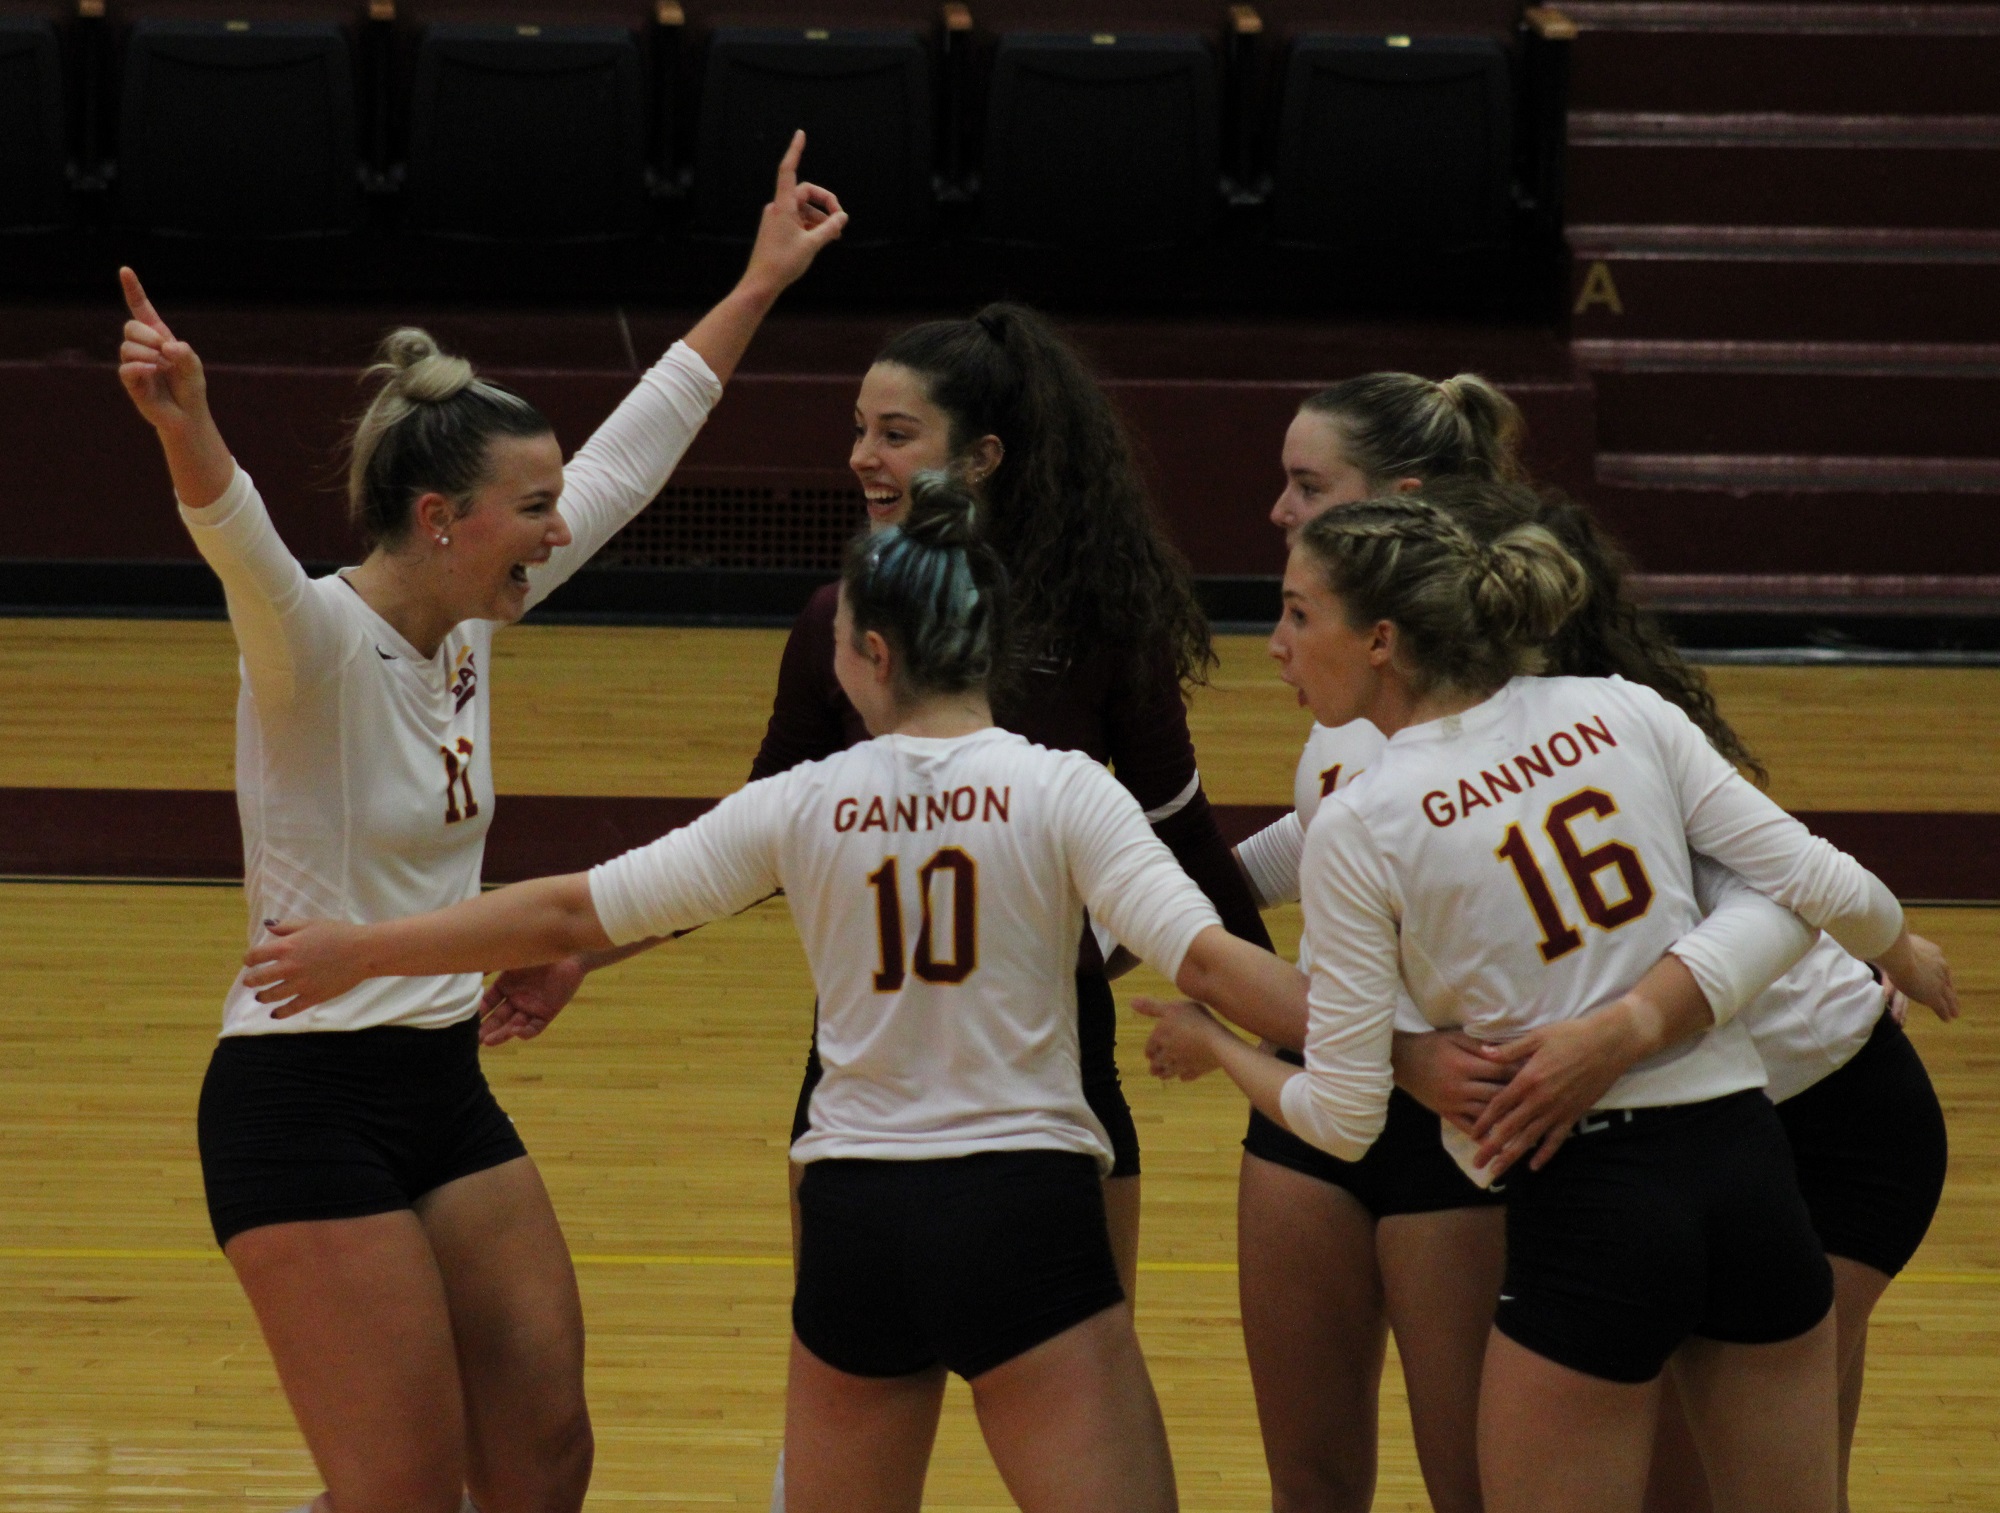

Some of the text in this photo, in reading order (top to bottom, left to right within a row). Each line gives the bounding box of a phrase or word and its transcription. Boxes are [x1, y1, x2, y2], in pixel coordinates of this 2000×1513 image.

[1574, 261, 1623, 314] A
[440, 736, 479, 824] 11
[833, 785, 1010, 833] GANNON
[1422, 715, 1617, 828] GANNON
[866, 845, 979, 994] 10
[1493, 785, 1656, 965] 16
